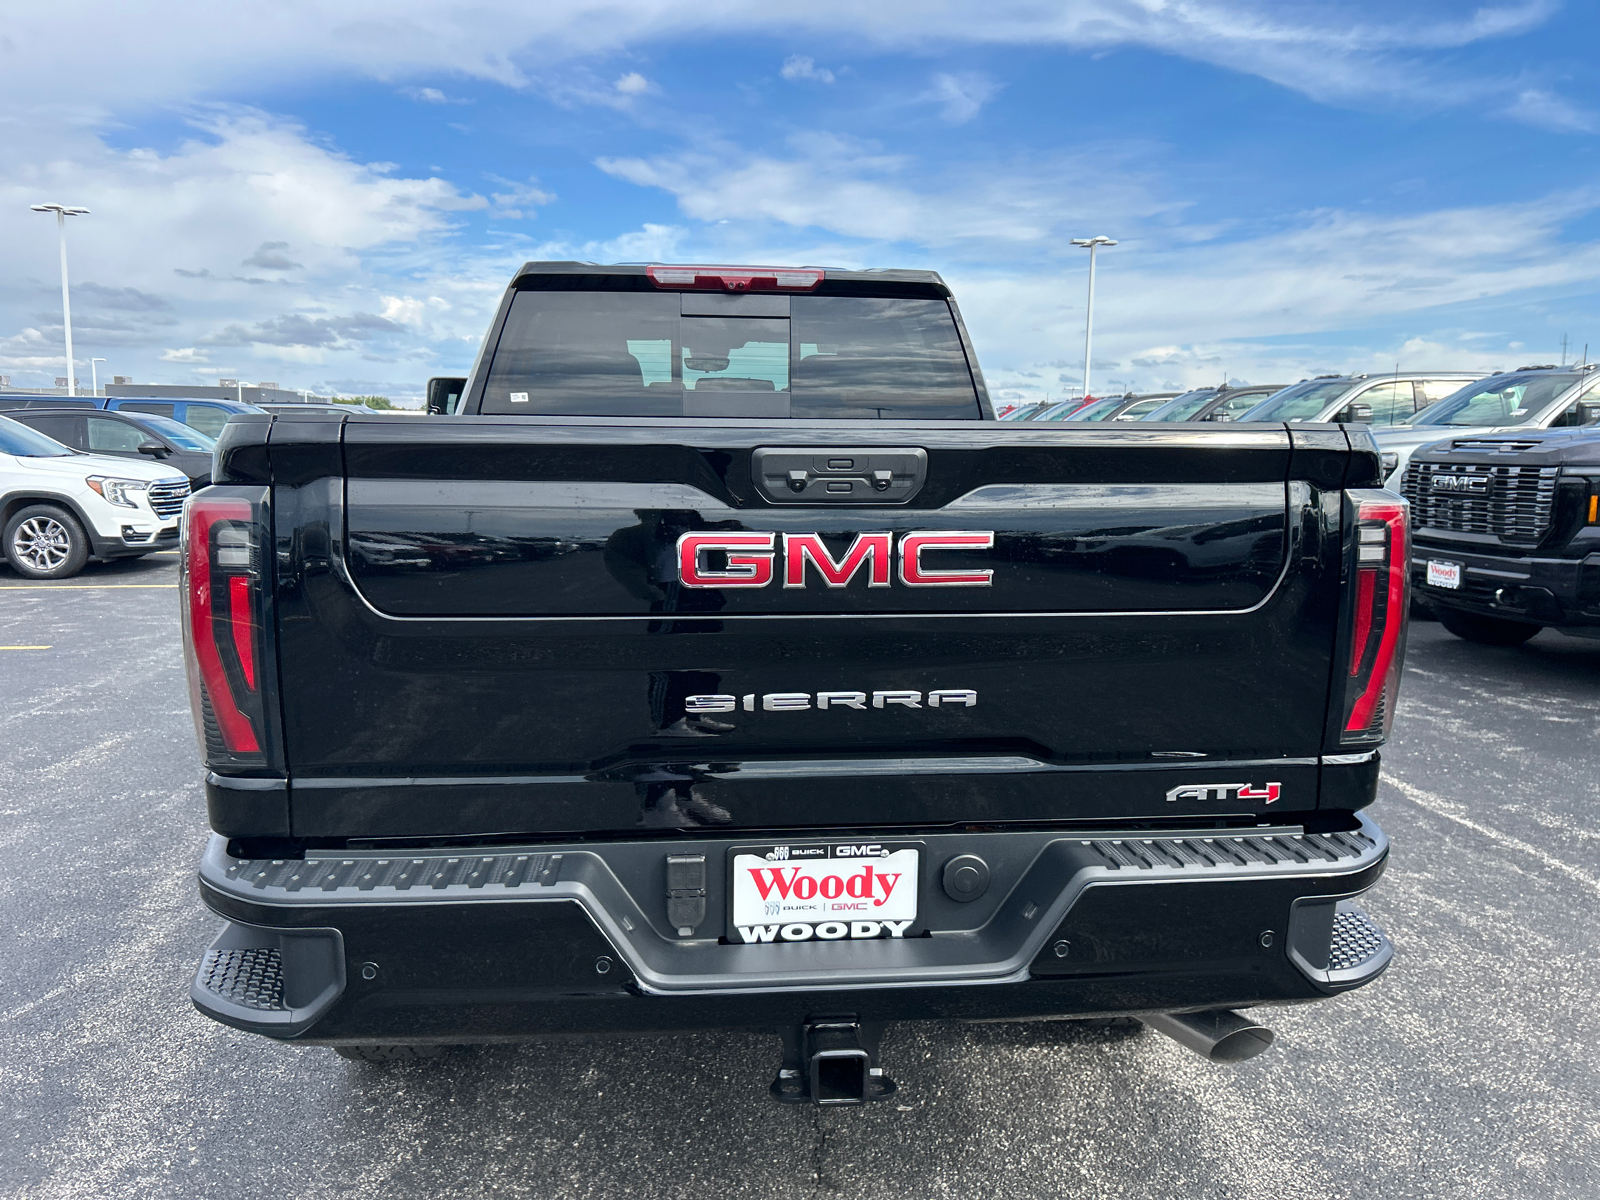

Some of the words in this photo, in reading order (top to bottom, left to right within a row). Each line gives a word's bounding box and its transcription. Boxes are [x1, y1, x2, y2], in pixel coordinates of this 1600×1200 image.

[1432, 475, 1488, 492] GMC
[676, 530, 995, 589] GMC
[1430, 564, 1458, 581] Woody
[684, 688, 978, 713] SIERRA
[1165, 781, 1282, 805] AT4
[791, 848, 825, 856] BUICK
[836, 845, 881, 856] GMC
[747, 865, 903, 907] Woody
[830, 902, 868, 911] GMC
[738, 920, 913, 944] WOODY
